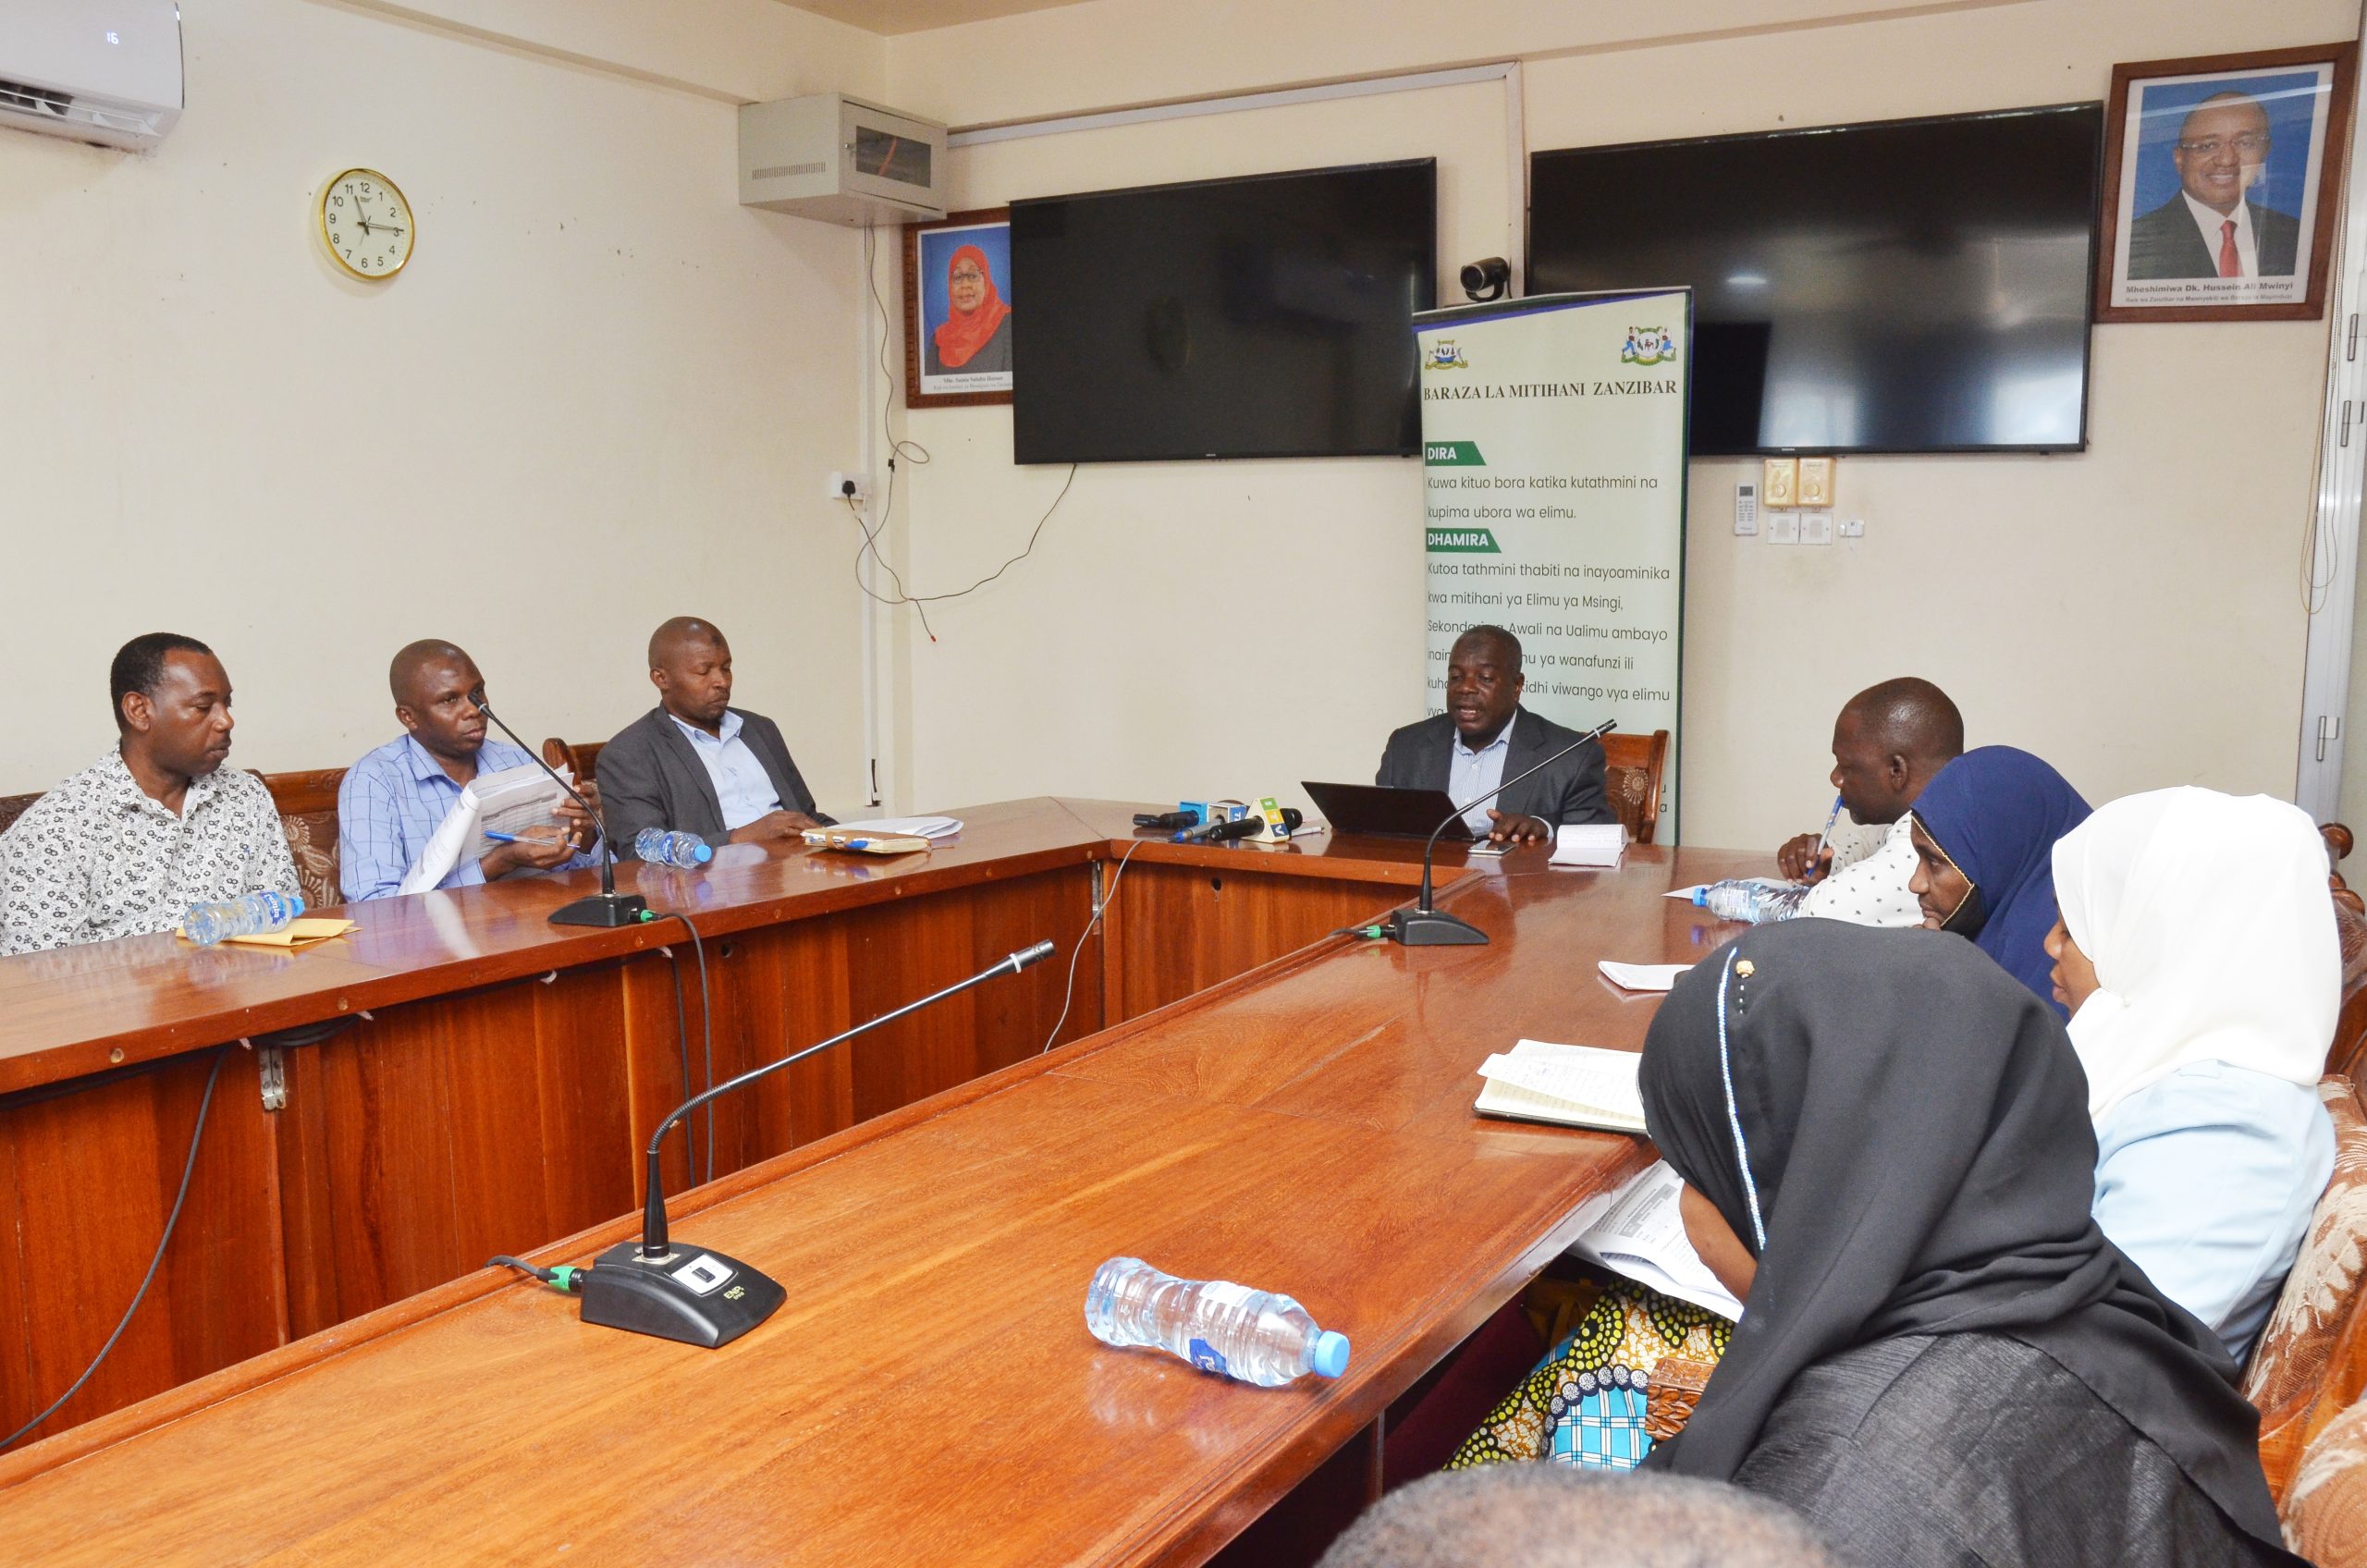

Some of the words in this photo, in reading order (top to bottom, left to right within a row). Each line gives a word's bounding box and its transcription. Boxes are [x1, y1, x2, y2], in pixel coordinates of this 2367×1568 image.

[107, 31, 119, 44] 16
[345, 184, 353, 194] 11
[360, 182, 370, 193] 12
[333, 196, 343, 207] 10
[379, 191, 383, 202] 1
[390, 207, 396, 217] 2
[329, 213, 336, 224] 9
[394, 227, 399, 237] 3
[333, 234, 339, 244] 8
[345, 249, 351, 259] 7
[389, 245, 395, 254] 4
[362, 258, 368, 268] 6
[377, 257, 384, 266] 5
[2203, 283, 2240, 291] Hussein
[1423, 386, 1481, 401] BARAZA
[1485, 385, 1505, 398] LA
[1509, 383, 1585, 398] MITIHANI
[1594, 380, 1677, 395] ZANZIBAR
[1428, 447, 1457, 459] DIRA
[1428, 476, 1457, 489] Kuwa
[1462, 476, 1490, 489] kituo
[1494, 476, 1526, 489] bora
[1529, 476, 1567, 489] katika
[1571, 476, 1637, 488] kutathmini
[1640, 479, 1658, 488] na
[1428, 506, 1469, 521] kupima
[1474, 506, 1512, 519] ubora
[1515, 509, 1535, 519] wa
[1539, 506, 1576, 519] elimu.
[1428, 533, 1489, 546] DHAMIRA
[1428, 563, 1458, 576] Kutoa
[1463, 563, 1515, 576] tathmini
[1520, 564, 1560, 577] thabiti
[1564, 568, 1579, 578] na
[1584, 565, 1670, 582] inayoaminika
[1428, 593, 1447, 604] kwa
[1451, 593, 1502, 605] mitihani
[1506, 596, 1522, 608] ya
[1527, 594, 1560, 606] Elimu
[1564, 597, 1578, 610] ya
[1582, 594, 1623, 613] Msingi,
[1509, 623, 1542, 636] Awali
[1546, 627, 1562, 636] na
[1566, 625, 1608, 639] Ualimu
[1612, 627, 1668, 643] ambayo
[1539, 655, 1555, 667] ya
[1559, 654, 1621, 669] wanafunzi
[1625, 656, 1633, 669] ili
[1551, 682, 1603, 701] viwango
[1607, 688, 1628, 703] vya
[1632, 688, 1670, 702] elimu
